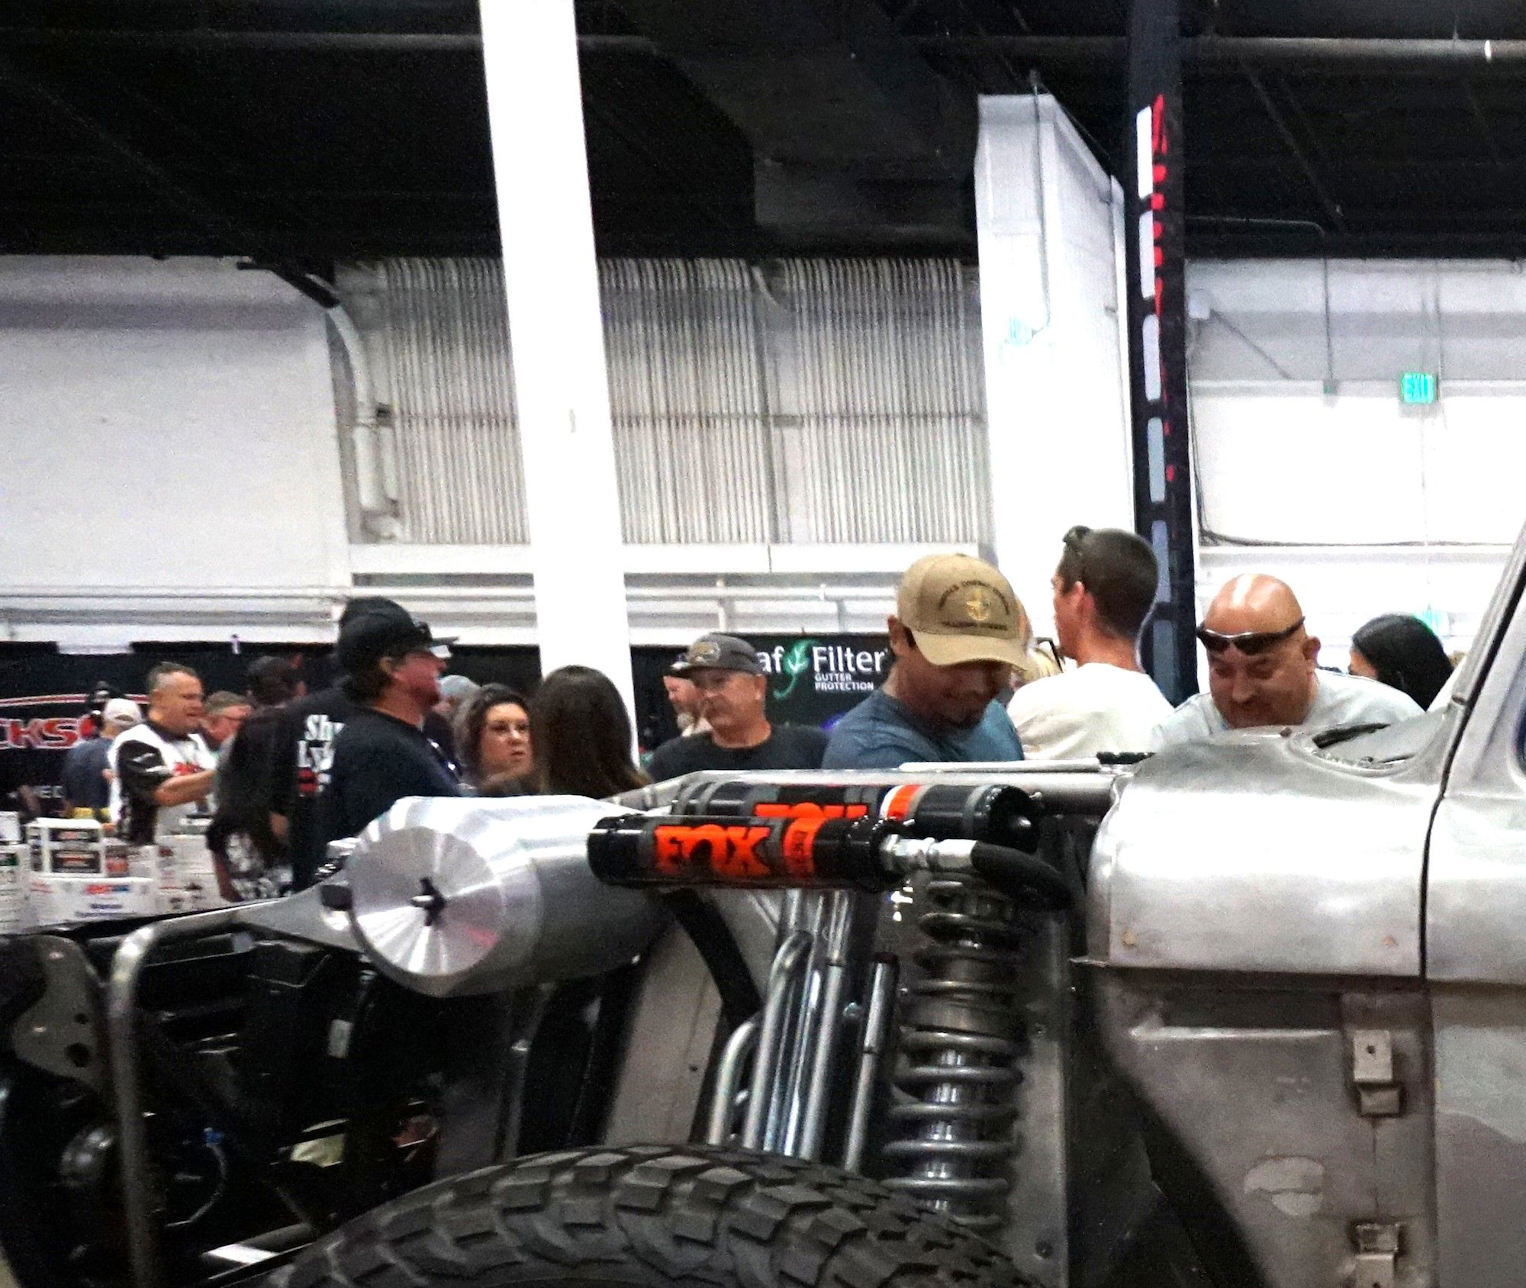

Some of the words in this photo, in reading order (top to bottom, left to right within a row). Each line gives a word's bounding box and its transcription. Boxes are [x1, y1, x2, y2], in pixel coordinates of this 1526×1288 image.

[812, 645, 884, 673] Filter
[814, 672, 852, 682] GUTTER
[814, 681, 875, 691] PROTECTION
[654, 823, 771, 877] FOX
